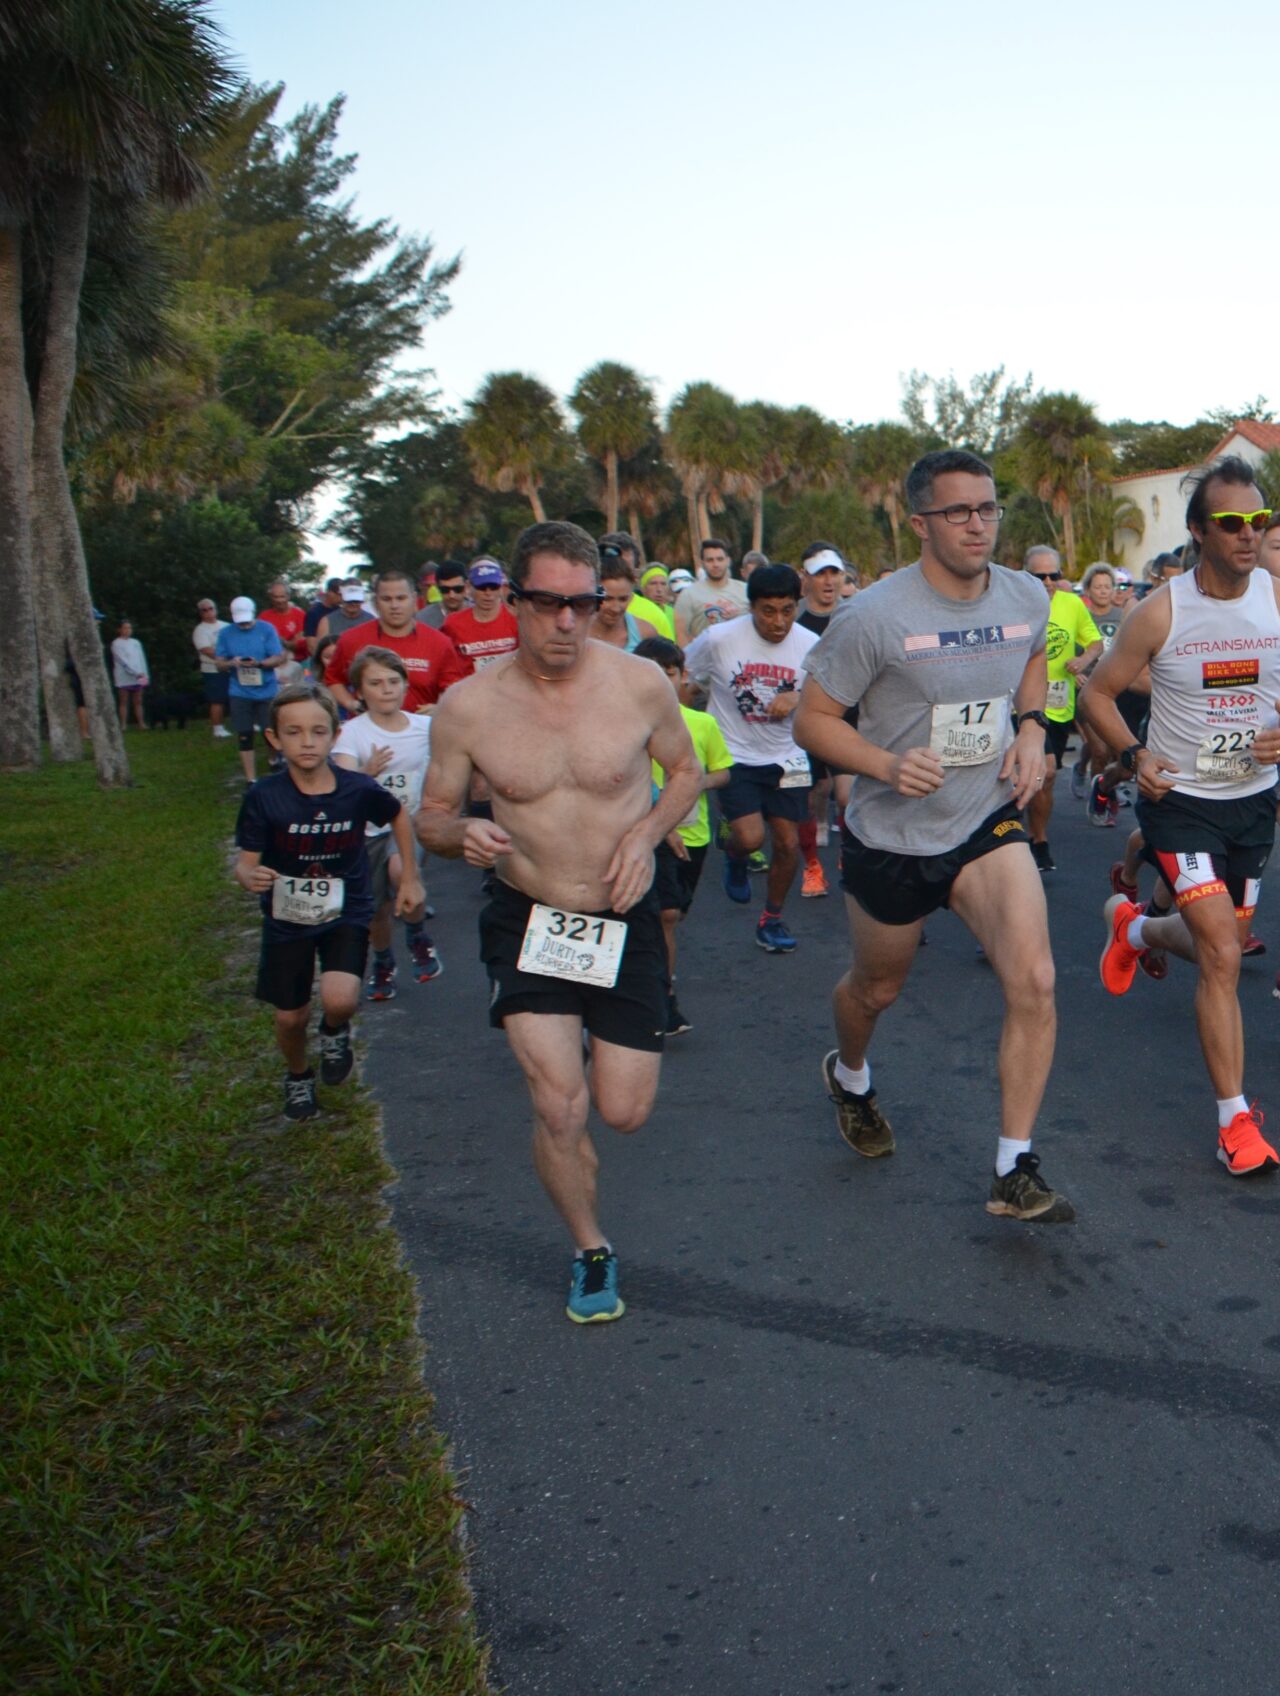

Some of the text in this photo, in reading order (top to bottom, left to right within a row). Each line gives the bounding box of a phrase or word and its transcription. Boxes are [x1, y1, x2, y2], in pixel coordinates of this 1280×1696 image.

[1176, 638, 1279, 656] LCTRAINSMART
[1207, 693, 1256, 709] TASOS
[960, 702, 991, 725] 17
[947, 729, 977, 748] DURTI
[1212, 729, 1256, 754] 223
[288, 821, 352, 834] BOSTON
[286, 880, 330, 897] 149
[547, 912, 605, 945] 321
[542, 936, 577, 962] DURTI
